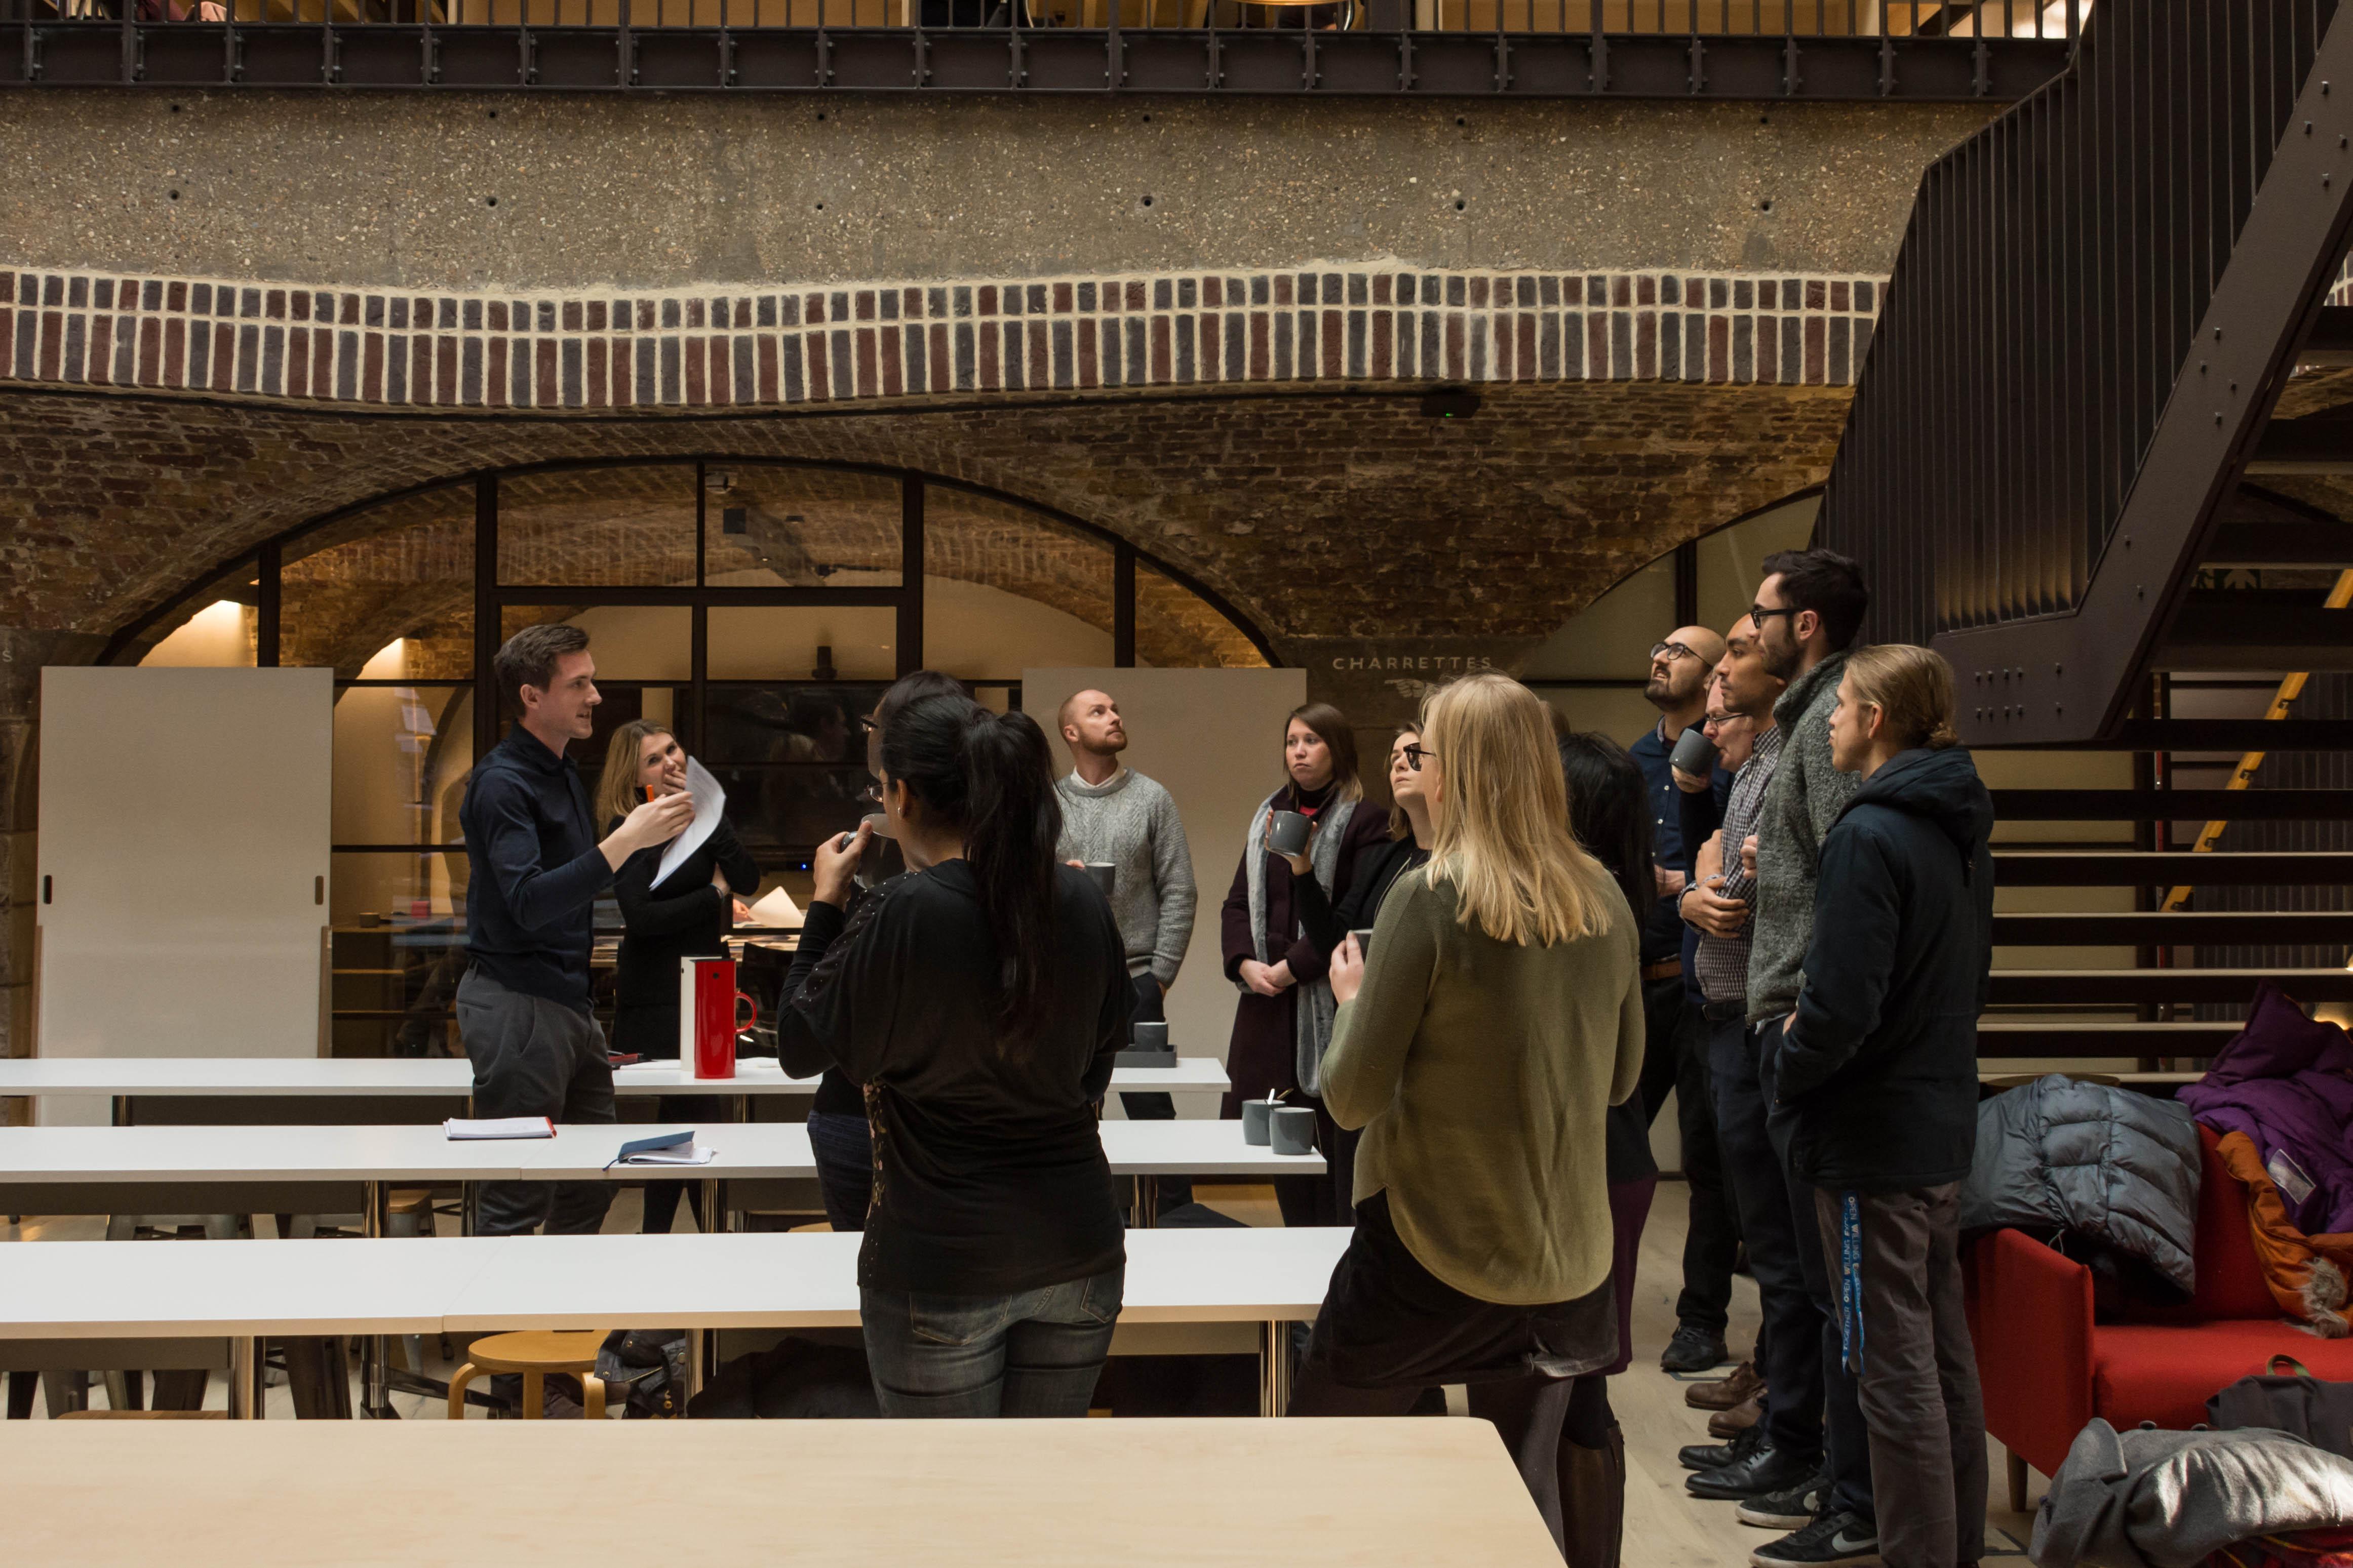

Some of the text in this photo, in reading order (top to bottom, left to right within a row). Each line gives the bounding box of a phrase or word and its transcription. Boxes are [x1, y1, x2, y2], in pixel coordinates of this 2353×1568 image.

[1332, 657, 1491, 670] CHARRETTES
[1848, 1196, 1858, 1220] OPEN
[1851, 1223, 1860, 1260] WILLING
[1843, 1279, 1851, 1303] OPEN
[1842, 1306, 1851, 1351] TOGETHER
